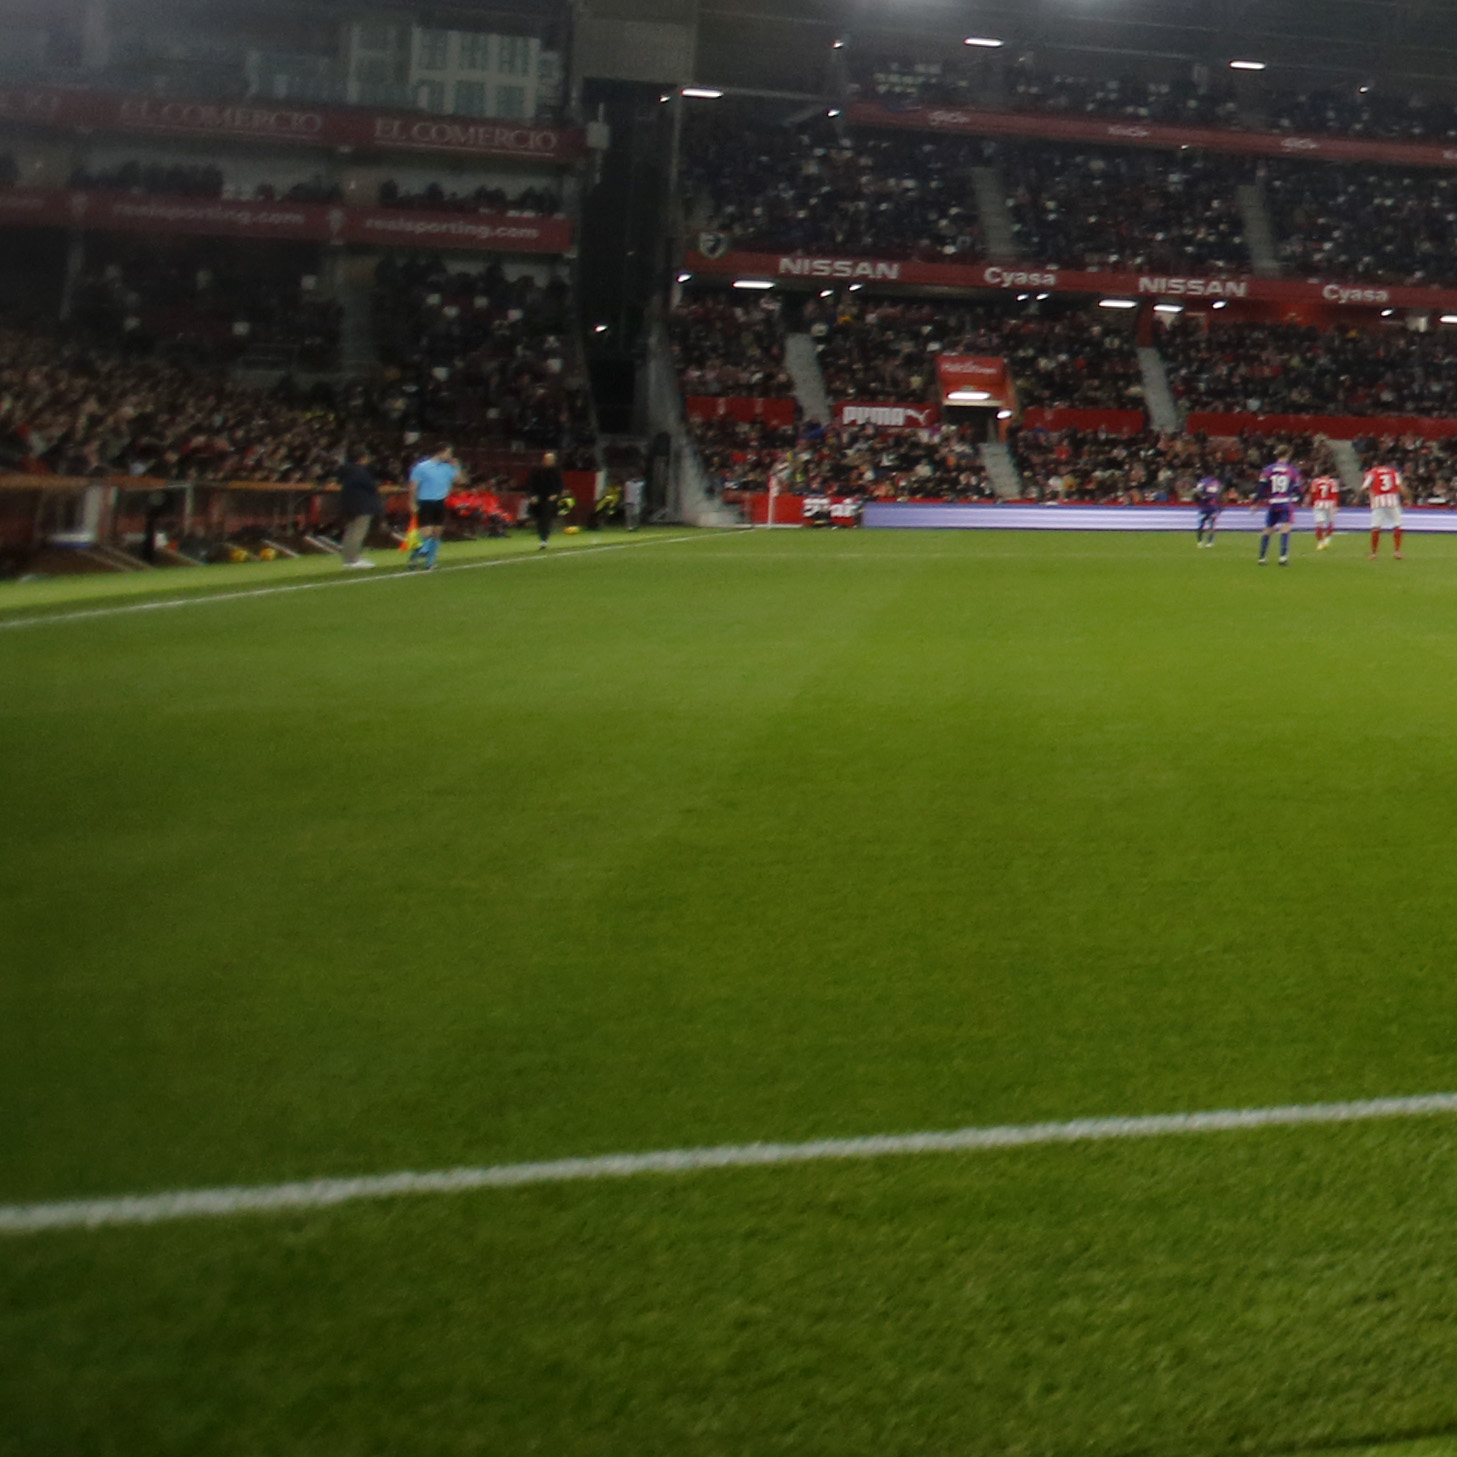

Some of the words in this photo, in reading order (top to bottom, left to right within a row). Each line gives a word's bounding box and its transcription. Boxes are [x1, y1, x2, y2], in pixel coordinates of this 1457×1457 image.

[374, 117, 405, 140] EL
[411, 121, 558, 150] COMERCIO
[779, 257, 900, 280] NISSAN
[983, 266, 1058, 287] Cyasa
[1138, 276, 1248, 297] NISSAN
[1322, 283, 1389, 304] Cyasa
[1270, 475, 1291, 493] 19
[1379, 475, 1394, 492] 3
